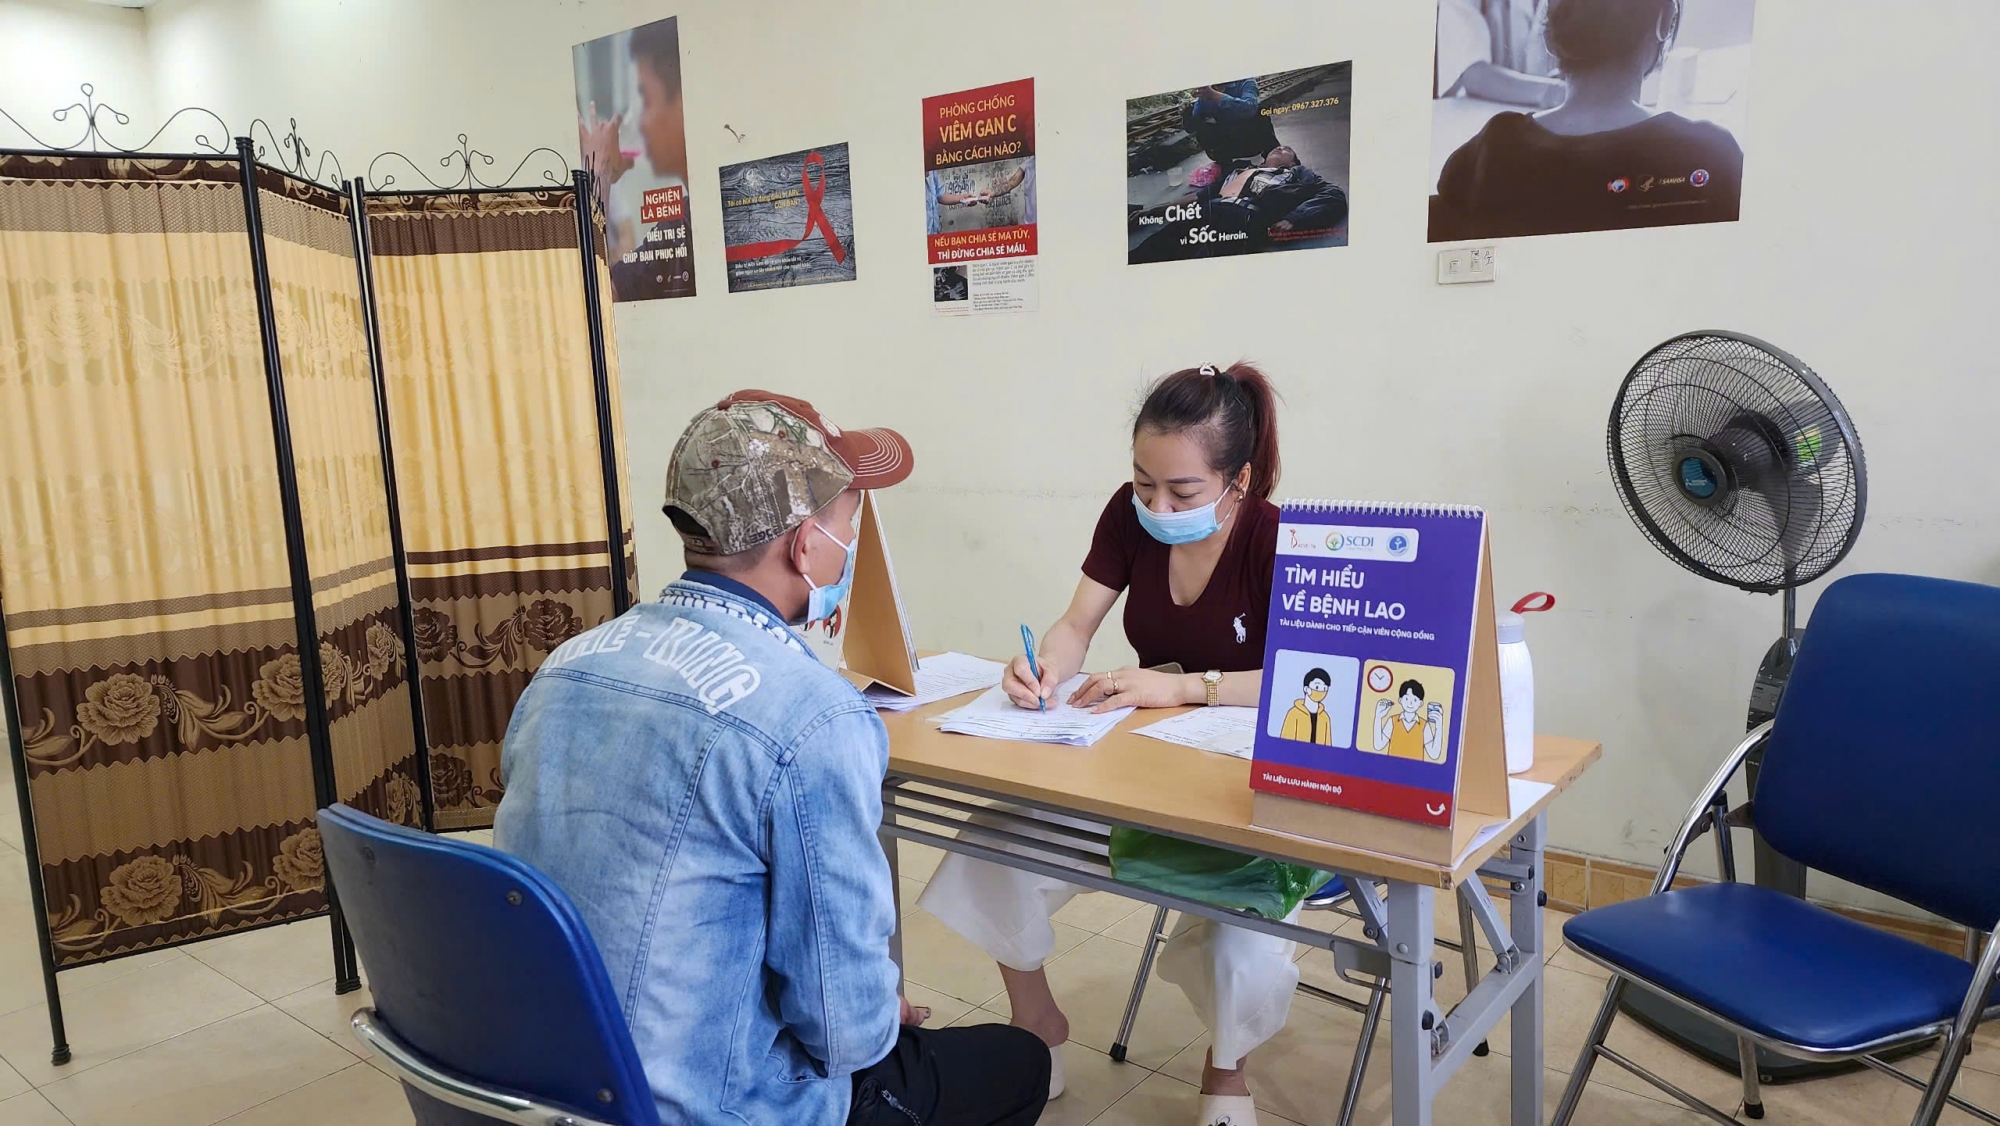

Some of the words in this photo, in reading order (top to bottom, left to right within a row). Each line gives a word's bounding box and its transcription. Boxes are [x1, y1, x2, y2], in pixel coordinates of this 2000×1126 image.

[940, 102, 975, 119] PHÒNG
[977, 94, 1015, 112] CHỐNG
[1261, 107, 1271, 117] Gọi
[1273, 104, 1291, 116] ngay:
[1292, 96, 1340, 111] 0967.327.376
[940, 120, 972, 144] VIÊM
[975, 118, 1004, 137] GAN
[1007, 114, 1017, 132] C
[936, 146, 963, 166] BẰNG
[964, 144, 992, 162] CÁCH
[994, 140, 1022, 156] NÀO?
[645, 188, 681, 205] NGHIỆN
[642, 206, 654, 220] LÀ
[656, 204, 682, 218] BỆNH
[1138, 214, 1164, 226] Không
[1165, 200, 1202, 223] Chết
[664, 228, 676, 242] TRỊ
[677, 225, 686, 239] SẼ
[934, 232, 950, 247] NẾU
[951, 232, 967, 247] BẠN
[968, 231, 986, 245] CHIA
[988, 229, 998, 242] SẺ
[999, 230, 1012, 241] MA
[1180, 234, 1187, 246] vì
[1188, 224, 1217, 245] Sốc
[1218, 230, 1249, 242] Heroin.
[623, 250, 638, 264] GIÚP
[640, 249, 654, 265] BẠN
[655, 248, 674, 263] PHỤC
[938, 248, 950, 260] THÌ
[951, 246, 975, 259] ĐỪNG
[976, 245, 994, 258] CHIA
[996, 243, 1005, 256] SẺ
[1006, 242, 1028, 255] MÁU.
[1346, 536, 1374, 548] SCDI
[1285, 563, 1316, 586] TÌM
[1321, 564, 1365, 590] HIỂU
[1282, 588, 1306, 612] VỀ
[1310, 593, 1361, 618] BỆNH
[1365, 600, 1406, 620] LAO
[1280, 617, 1289, 627] TÀI
[1290, 618, 1305, 629] LIỆU
[1306, 620, 1324, 630] DÀNH
[1326, 622, 1341, 632] CHO
[1342, 621, 1358, 634] TIẾP
[1358, 623, 1372, 636] CẬN
[1374, 624, 1390, 636] VIÊN
[1390, 626, 1411, 640] CỘNG
[1412, 628, 1434, 641] ĐỒNG
[1262, 772, 1272, 781] TÀI
[1273, 775, 1286, 784] LIỆU
[1287, 777, 1300, 786] LƯU
[1301, 779, 1319, 790] HÀNH
[1320, 783, 1332, 792] NỘI
[1332, 786, 1342, 795] BỘ
